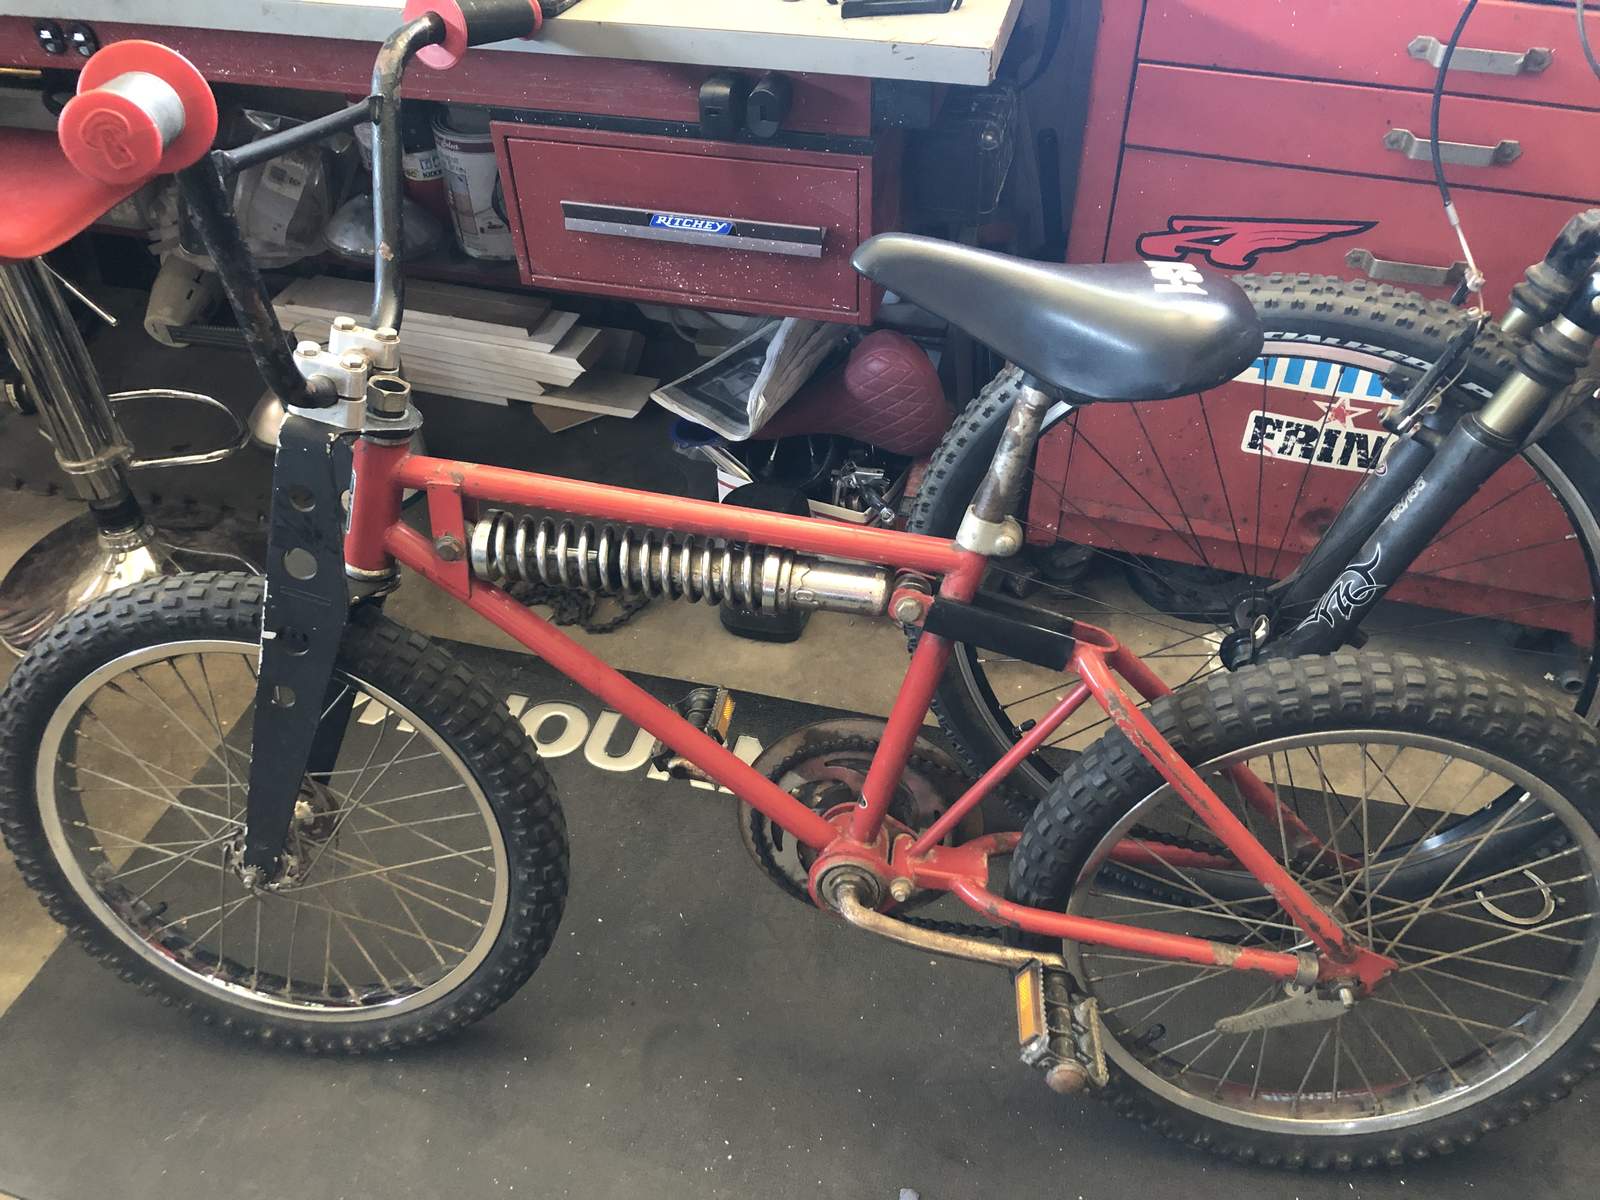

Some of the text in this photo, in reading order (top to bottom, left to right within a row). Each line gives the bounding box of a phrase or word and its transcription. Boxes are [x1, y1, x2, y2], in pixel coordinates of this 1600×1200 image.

[656, 214, 727, 232] RITCHEY
[1264, 331, 1433, 371] CIALIZED
[1247, 415, 1389, 470] FRIN
